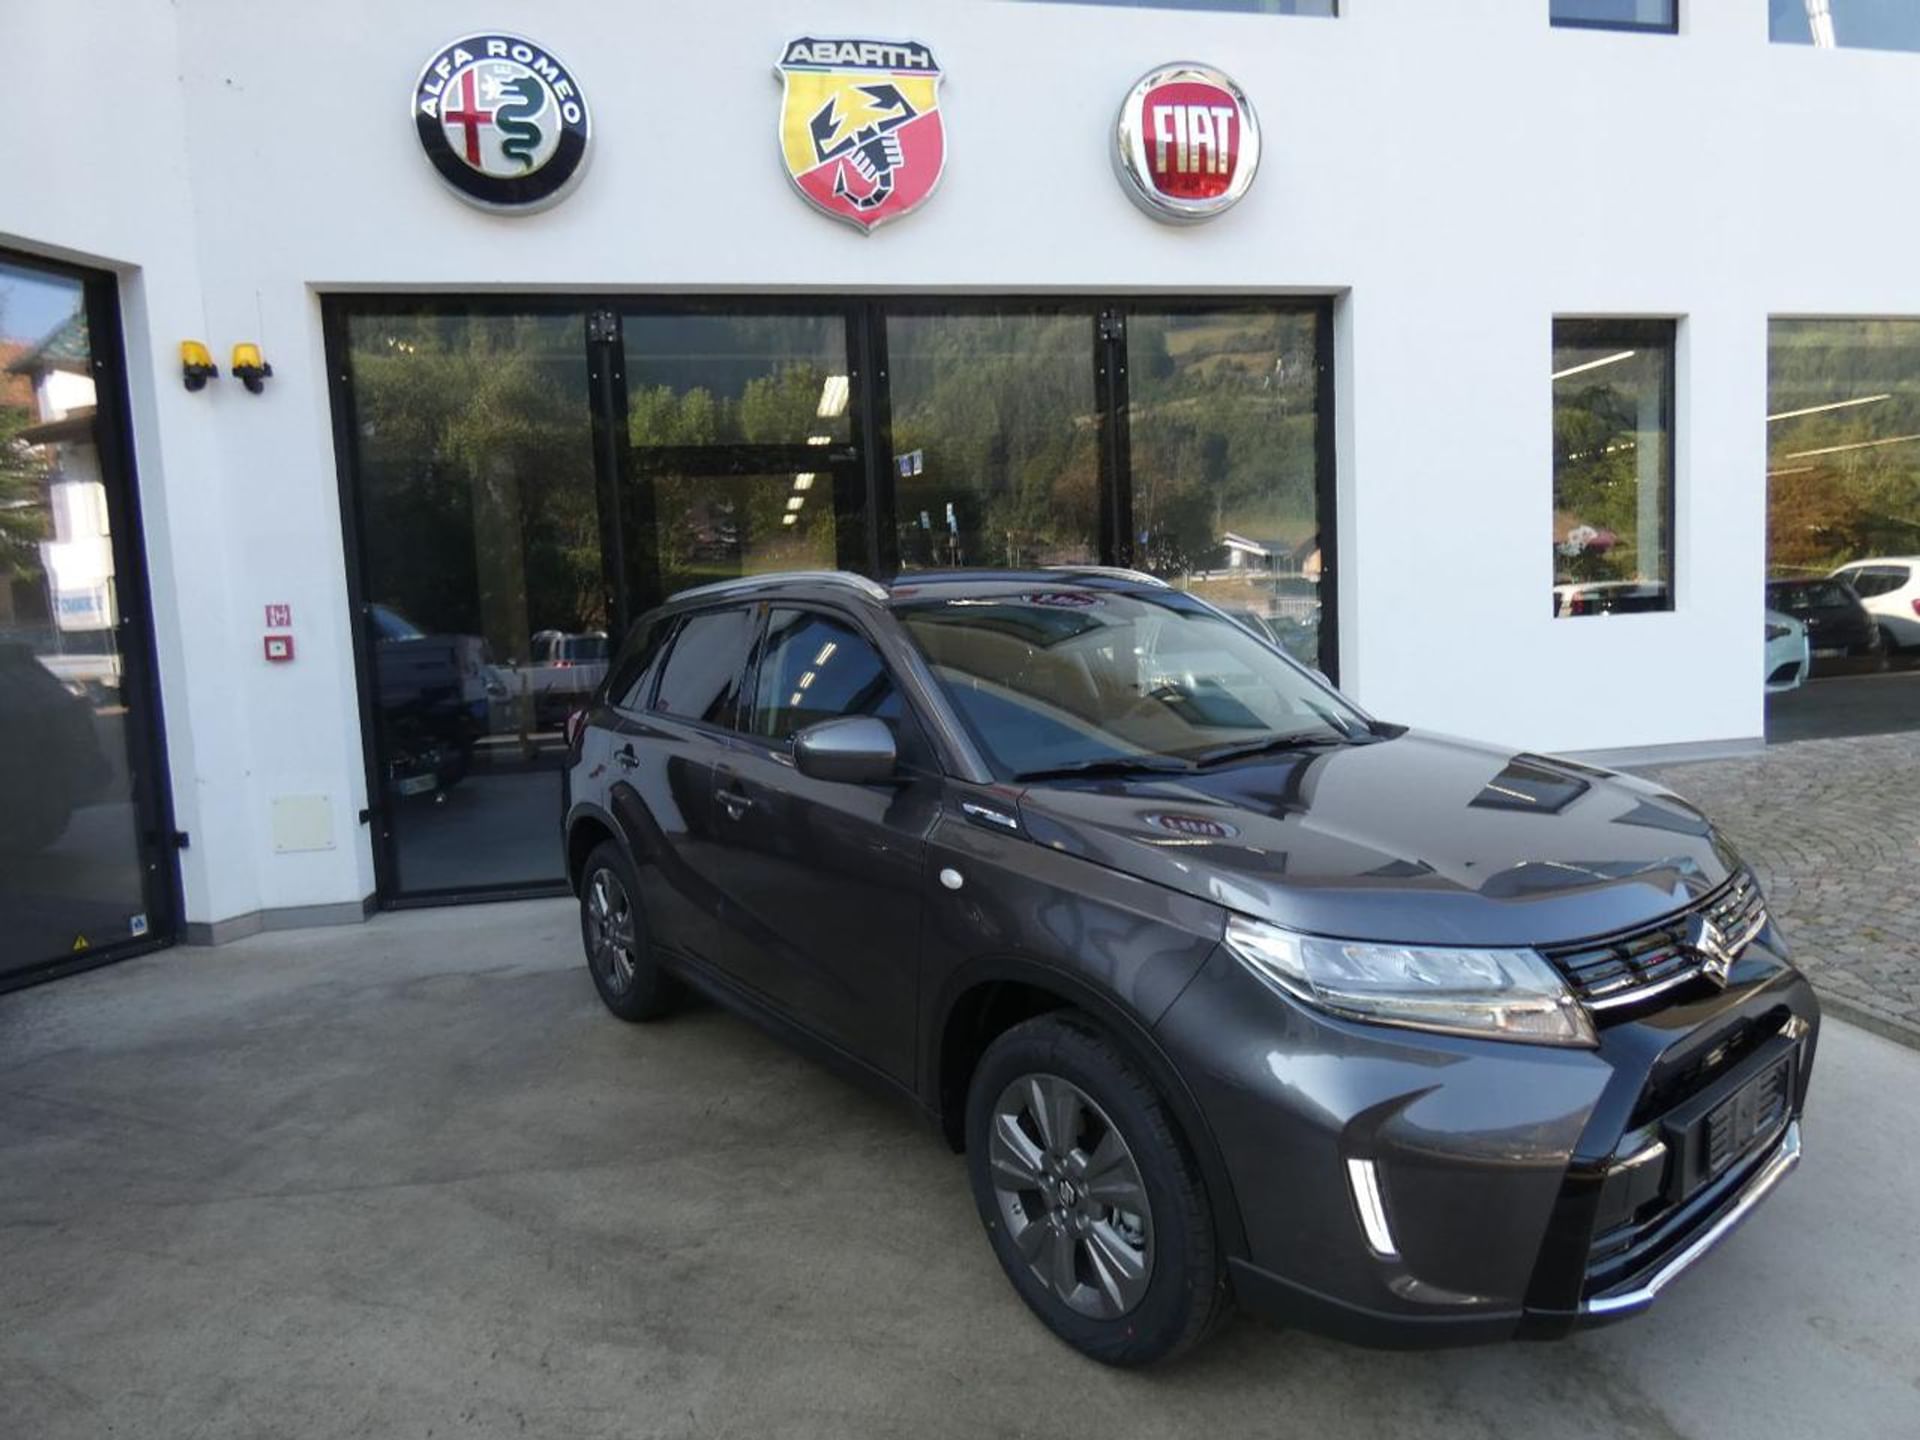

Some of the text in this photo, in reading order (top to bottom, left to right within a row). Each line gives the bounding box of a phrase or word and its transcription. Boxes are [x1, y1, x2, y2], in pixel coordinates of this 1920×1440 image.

[420, 39, 581, 124] ALFA ROMEO
[787, 42, 929, 68] ABARTH
[1152, 104, 1234, 175] FIAT
